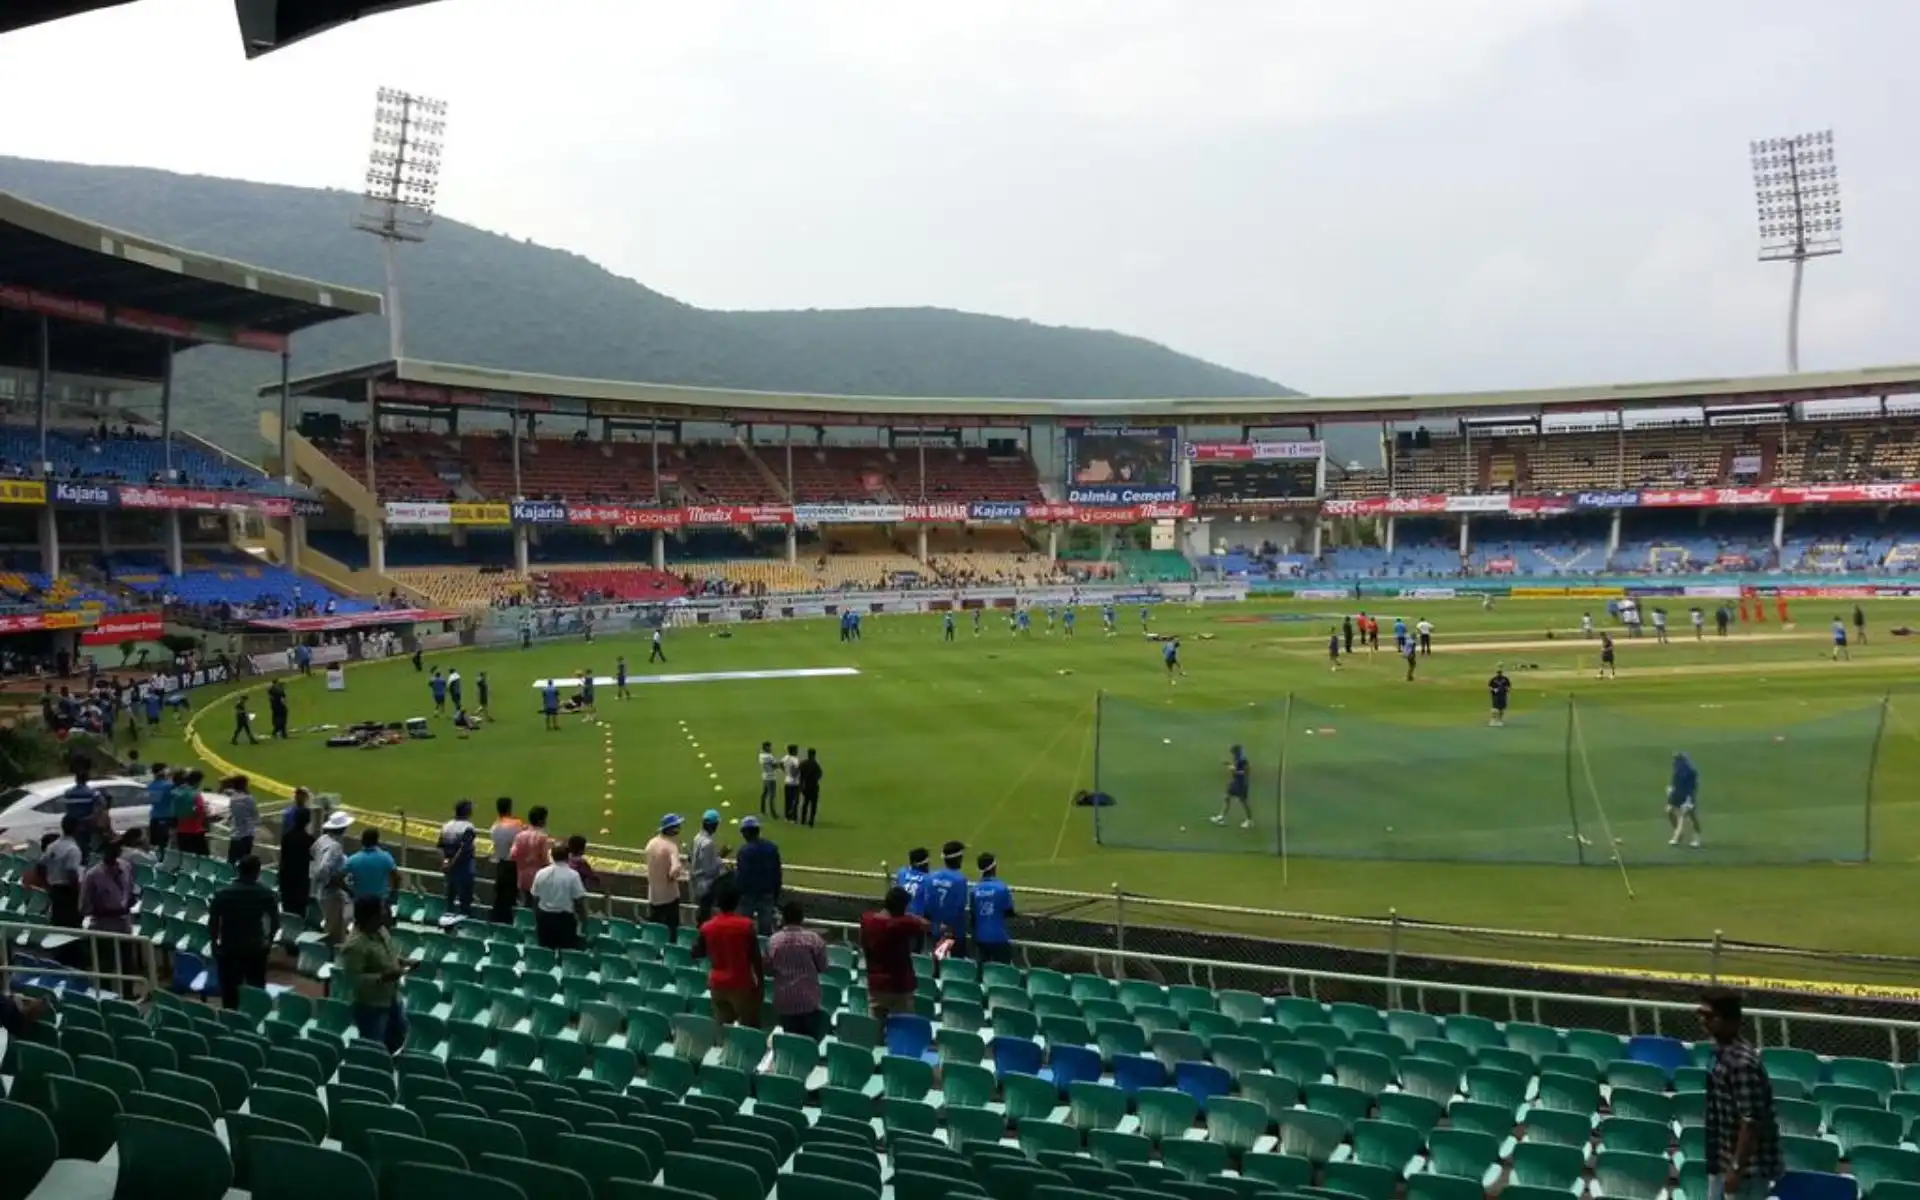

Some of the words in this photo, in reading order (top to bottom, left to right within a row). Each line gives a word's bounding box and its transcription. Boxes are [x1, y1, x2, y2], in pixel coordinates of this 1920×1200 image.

[56, 483, 109, 504] Kajaria
[1069, 490, 1118, 502] Dalmia
[1122, 490, 1176, 502] Cement
[1578, 491, 1637, 506] Kajaria
[513, 505, 565, 521] Kajaria
[904, 504, 927, 518] PAN
[929, 504, 968, 518] BAHAR
[972, 504, 1021, 518] Kajaria
